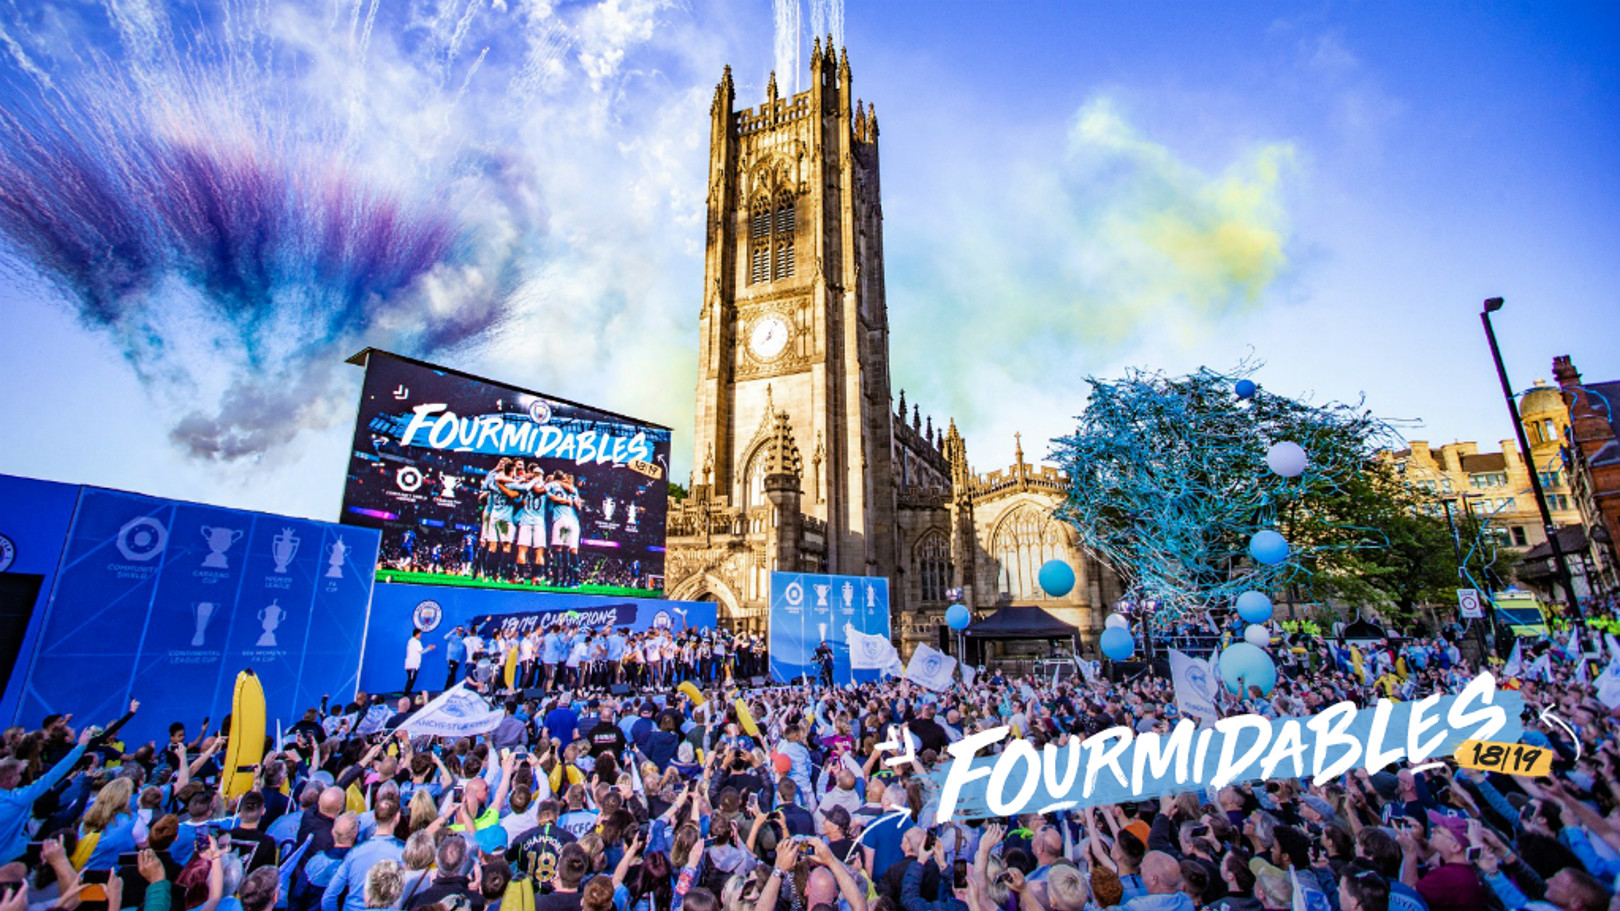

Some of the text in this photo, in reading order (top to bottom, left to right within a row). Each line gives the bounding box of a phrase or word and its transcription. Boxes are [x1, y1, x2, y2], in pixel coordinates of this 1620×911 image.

[400, 402, 649, 467] FOURMIDABLES
[107, 563, 158, 573] COMMUNITY
[117, 571, 148, 580] SHIELD
[527, 851, 557, 882] 18
